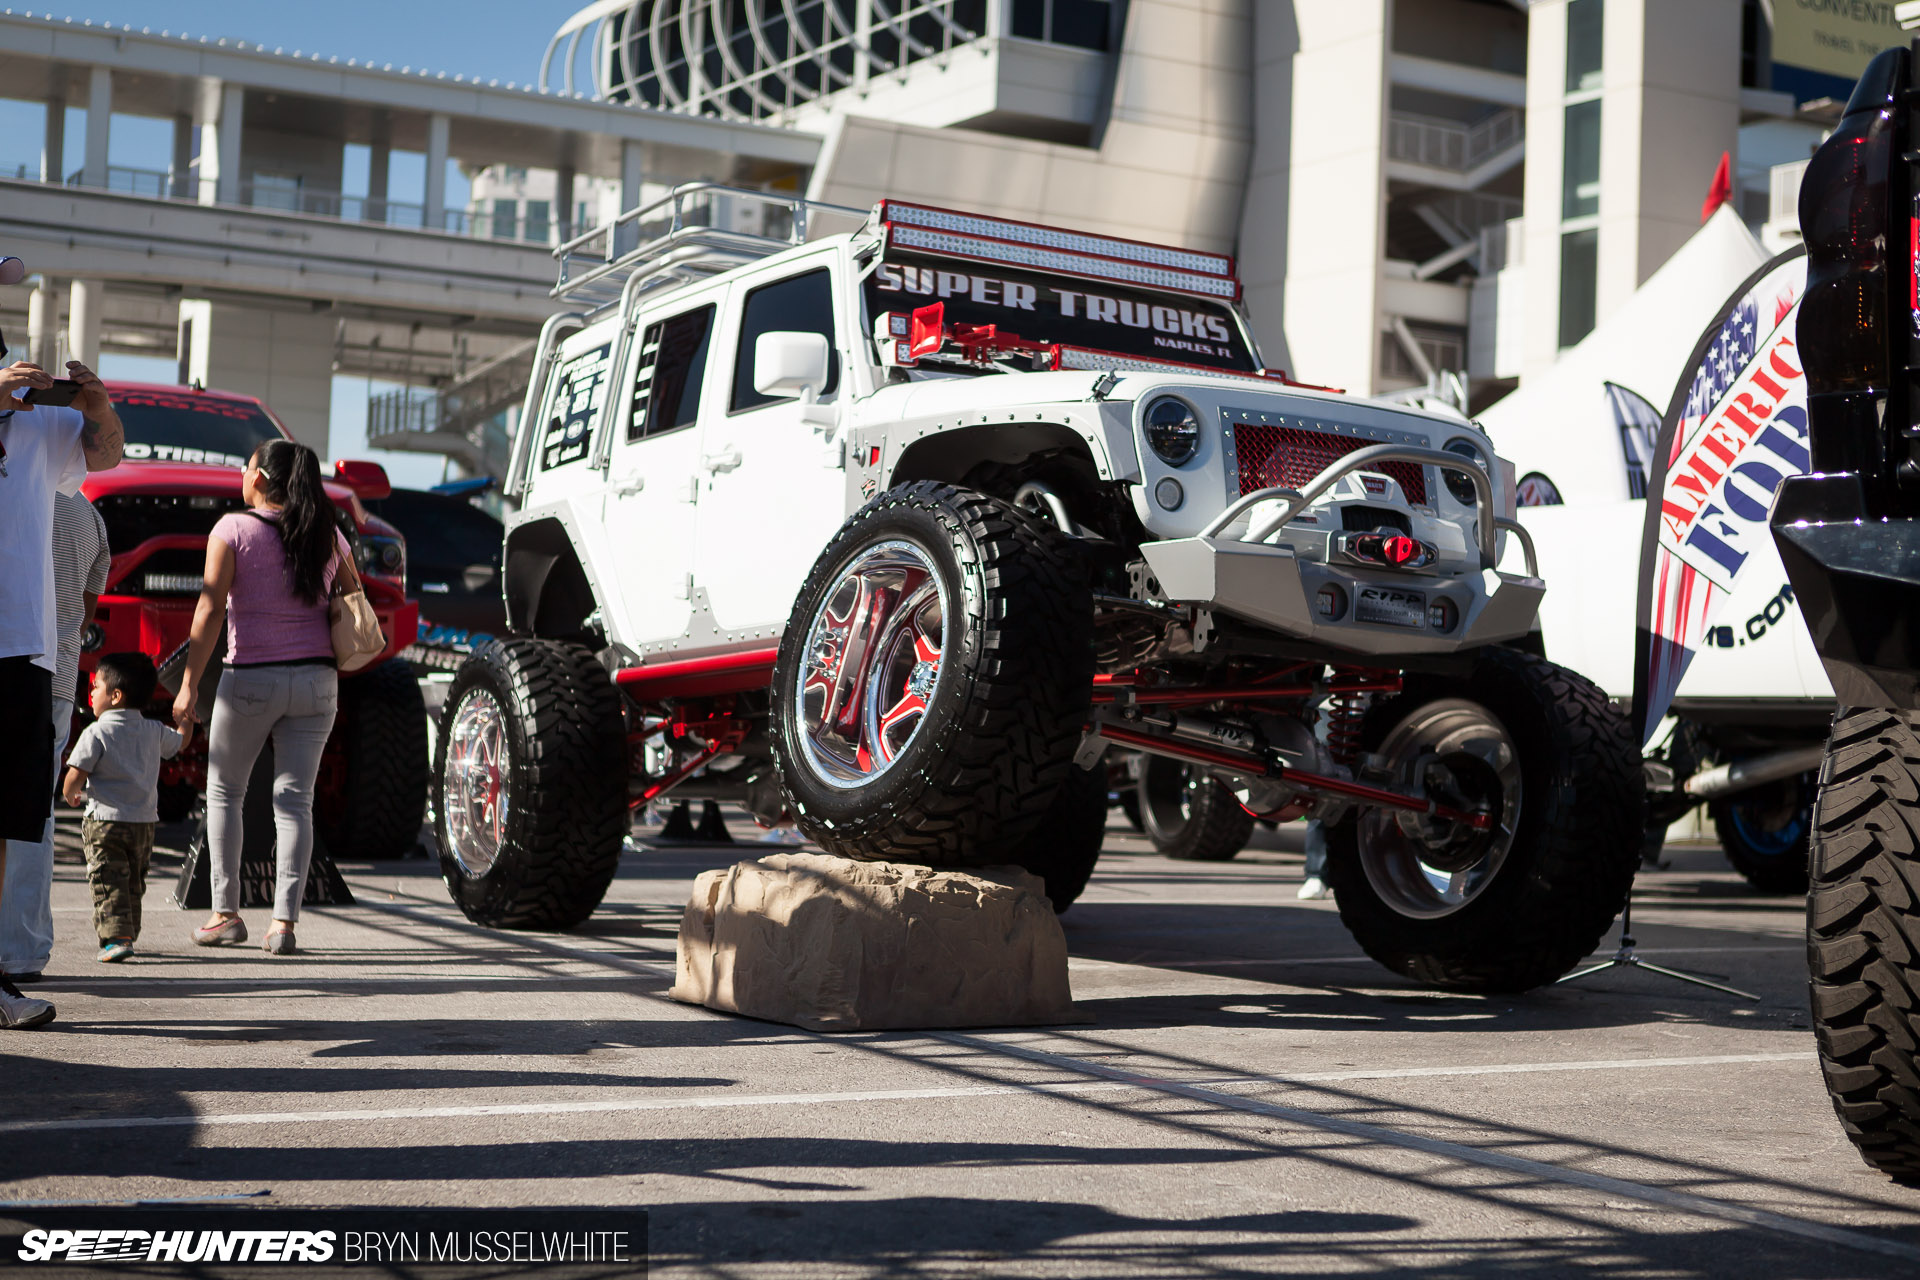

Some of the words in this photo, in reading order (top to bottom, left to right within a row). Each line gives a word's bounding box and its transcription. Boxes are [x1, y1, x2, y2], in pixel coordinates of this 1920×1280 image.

[876, 264, 1036, 312] SUPER
[1049, 289, 1231, 343] TRUCKS
[1217, 347, 1234, 359] FL
[153, 445, 246, 467] TIRES
[243, 877, 331, 903] FOCE
